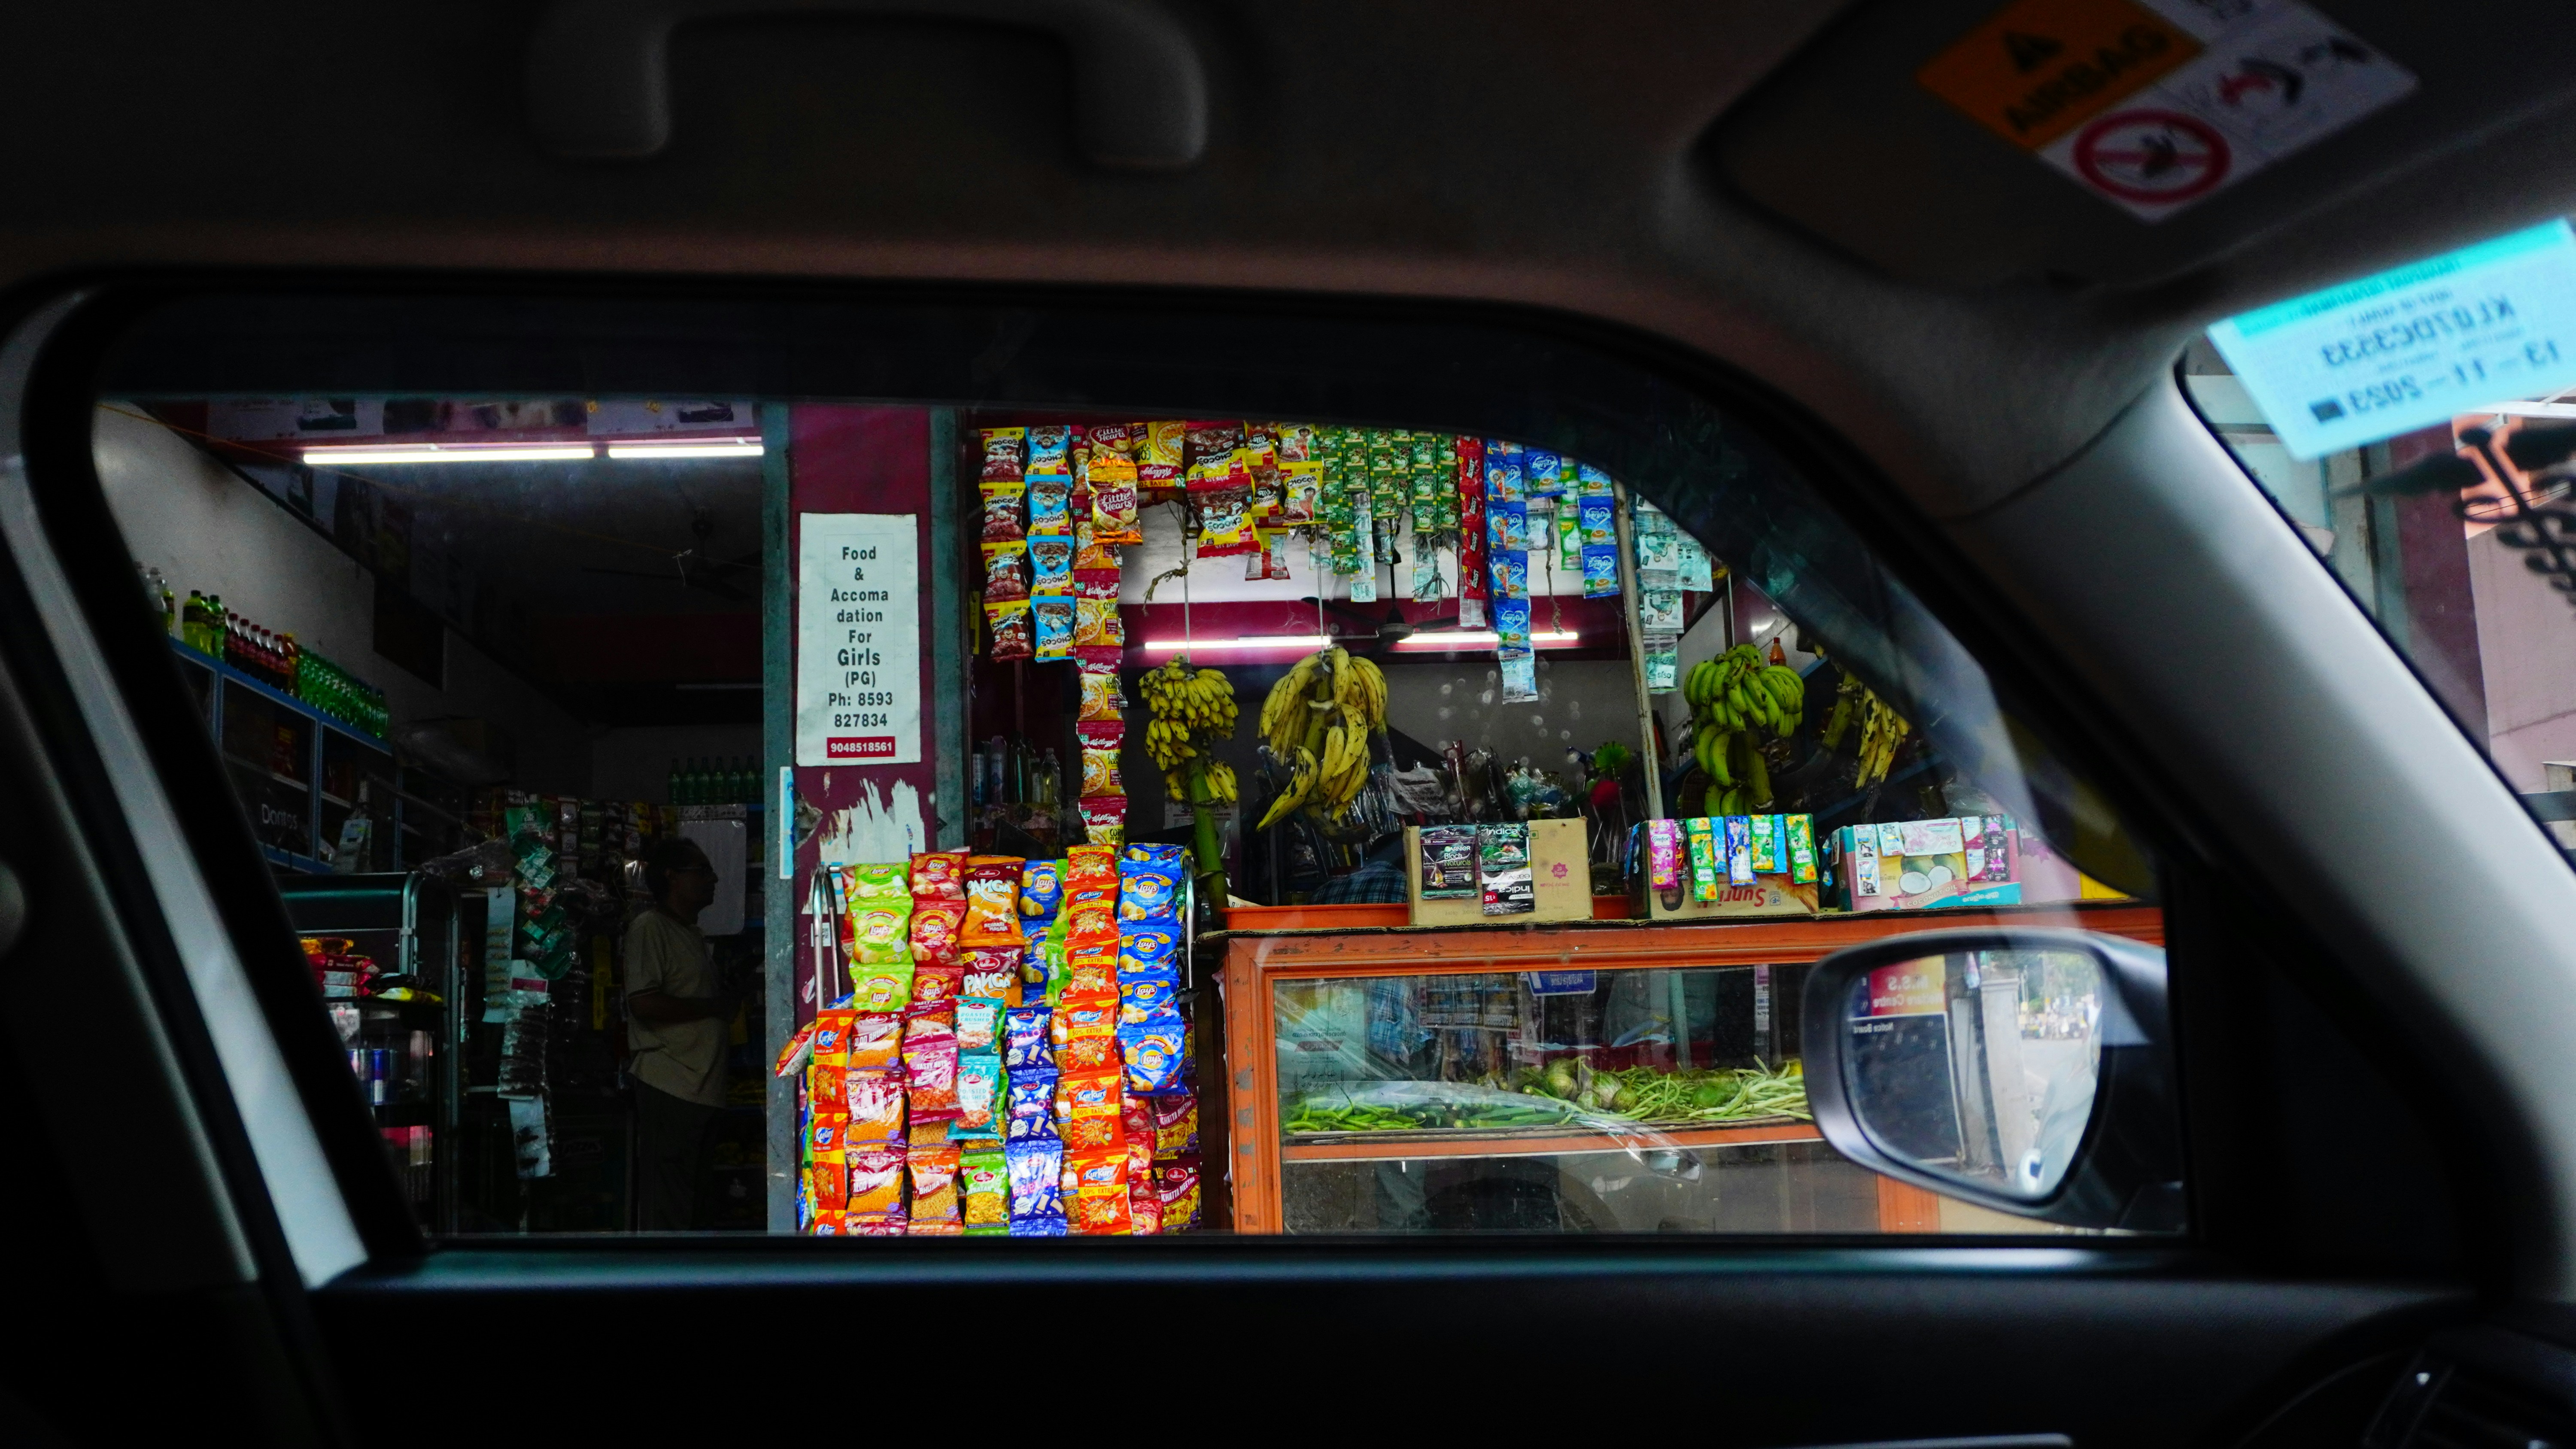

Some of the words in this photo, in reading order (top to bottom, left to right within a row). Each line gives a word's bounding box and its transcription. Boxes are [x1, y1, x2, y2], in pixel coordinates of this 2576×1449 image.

[986, 438, 1018, 448] CHOCOS
[1099, 432, 1126, 441] Hearts
[1198, 452, 1233, 465] CHOCOS
[1287, 475, 1316, 487] CHOCOS
[1101, 490, 1131, 503] Little
[1104, 498, 1133, 511] Hearts
[1034, 513, 1065, 524] CHOCOS
[842, 547, 876, 560] Food
[854, 568, 864, 581] &
[1036, 574, 1068, 585] CHOCOS
[831, 588, 889, 602] Accoma
[837, 609, 883, 623] dation
[1501, 614, 1526, 623] EveryDay
[849, 629, 872, 643] For
[1041, 635, 1072, 646] CHOCOS
[837, 648, 881, 666] Girls
[845, 671, 876, 688] (PG)
[829, 693, 851, 707] Ph:
[858, 692, 893, 706] 8593
[834, 714, 887, 728] 827834
[830, 741, 893, 753] 9048518561
[1090, 738, 1118, 747] Kellogg's
[1794, 854, 1813, 863] Comfort
[1498, 885, 1530, 894] Indica
[1907, 890, 1944, 907] COCONUT
[963, 972, 1011, 995] PANGA
[854, 1036, 867, 1047] ALOO
[1160, 1112, 1178, 1126] KHATTA
[1178, 1100, 1192, 1117] MEETHA
[853, 1183, 866, 1192] ALOO
[919, 1181, 939, 1195] BHUJIA
[1012, 1176, 1059, 1199] PEELOZ
[1160, 1187, 1180, 1202] KHATTA
[1180, 1176, 1195, 1193] MEETHA
